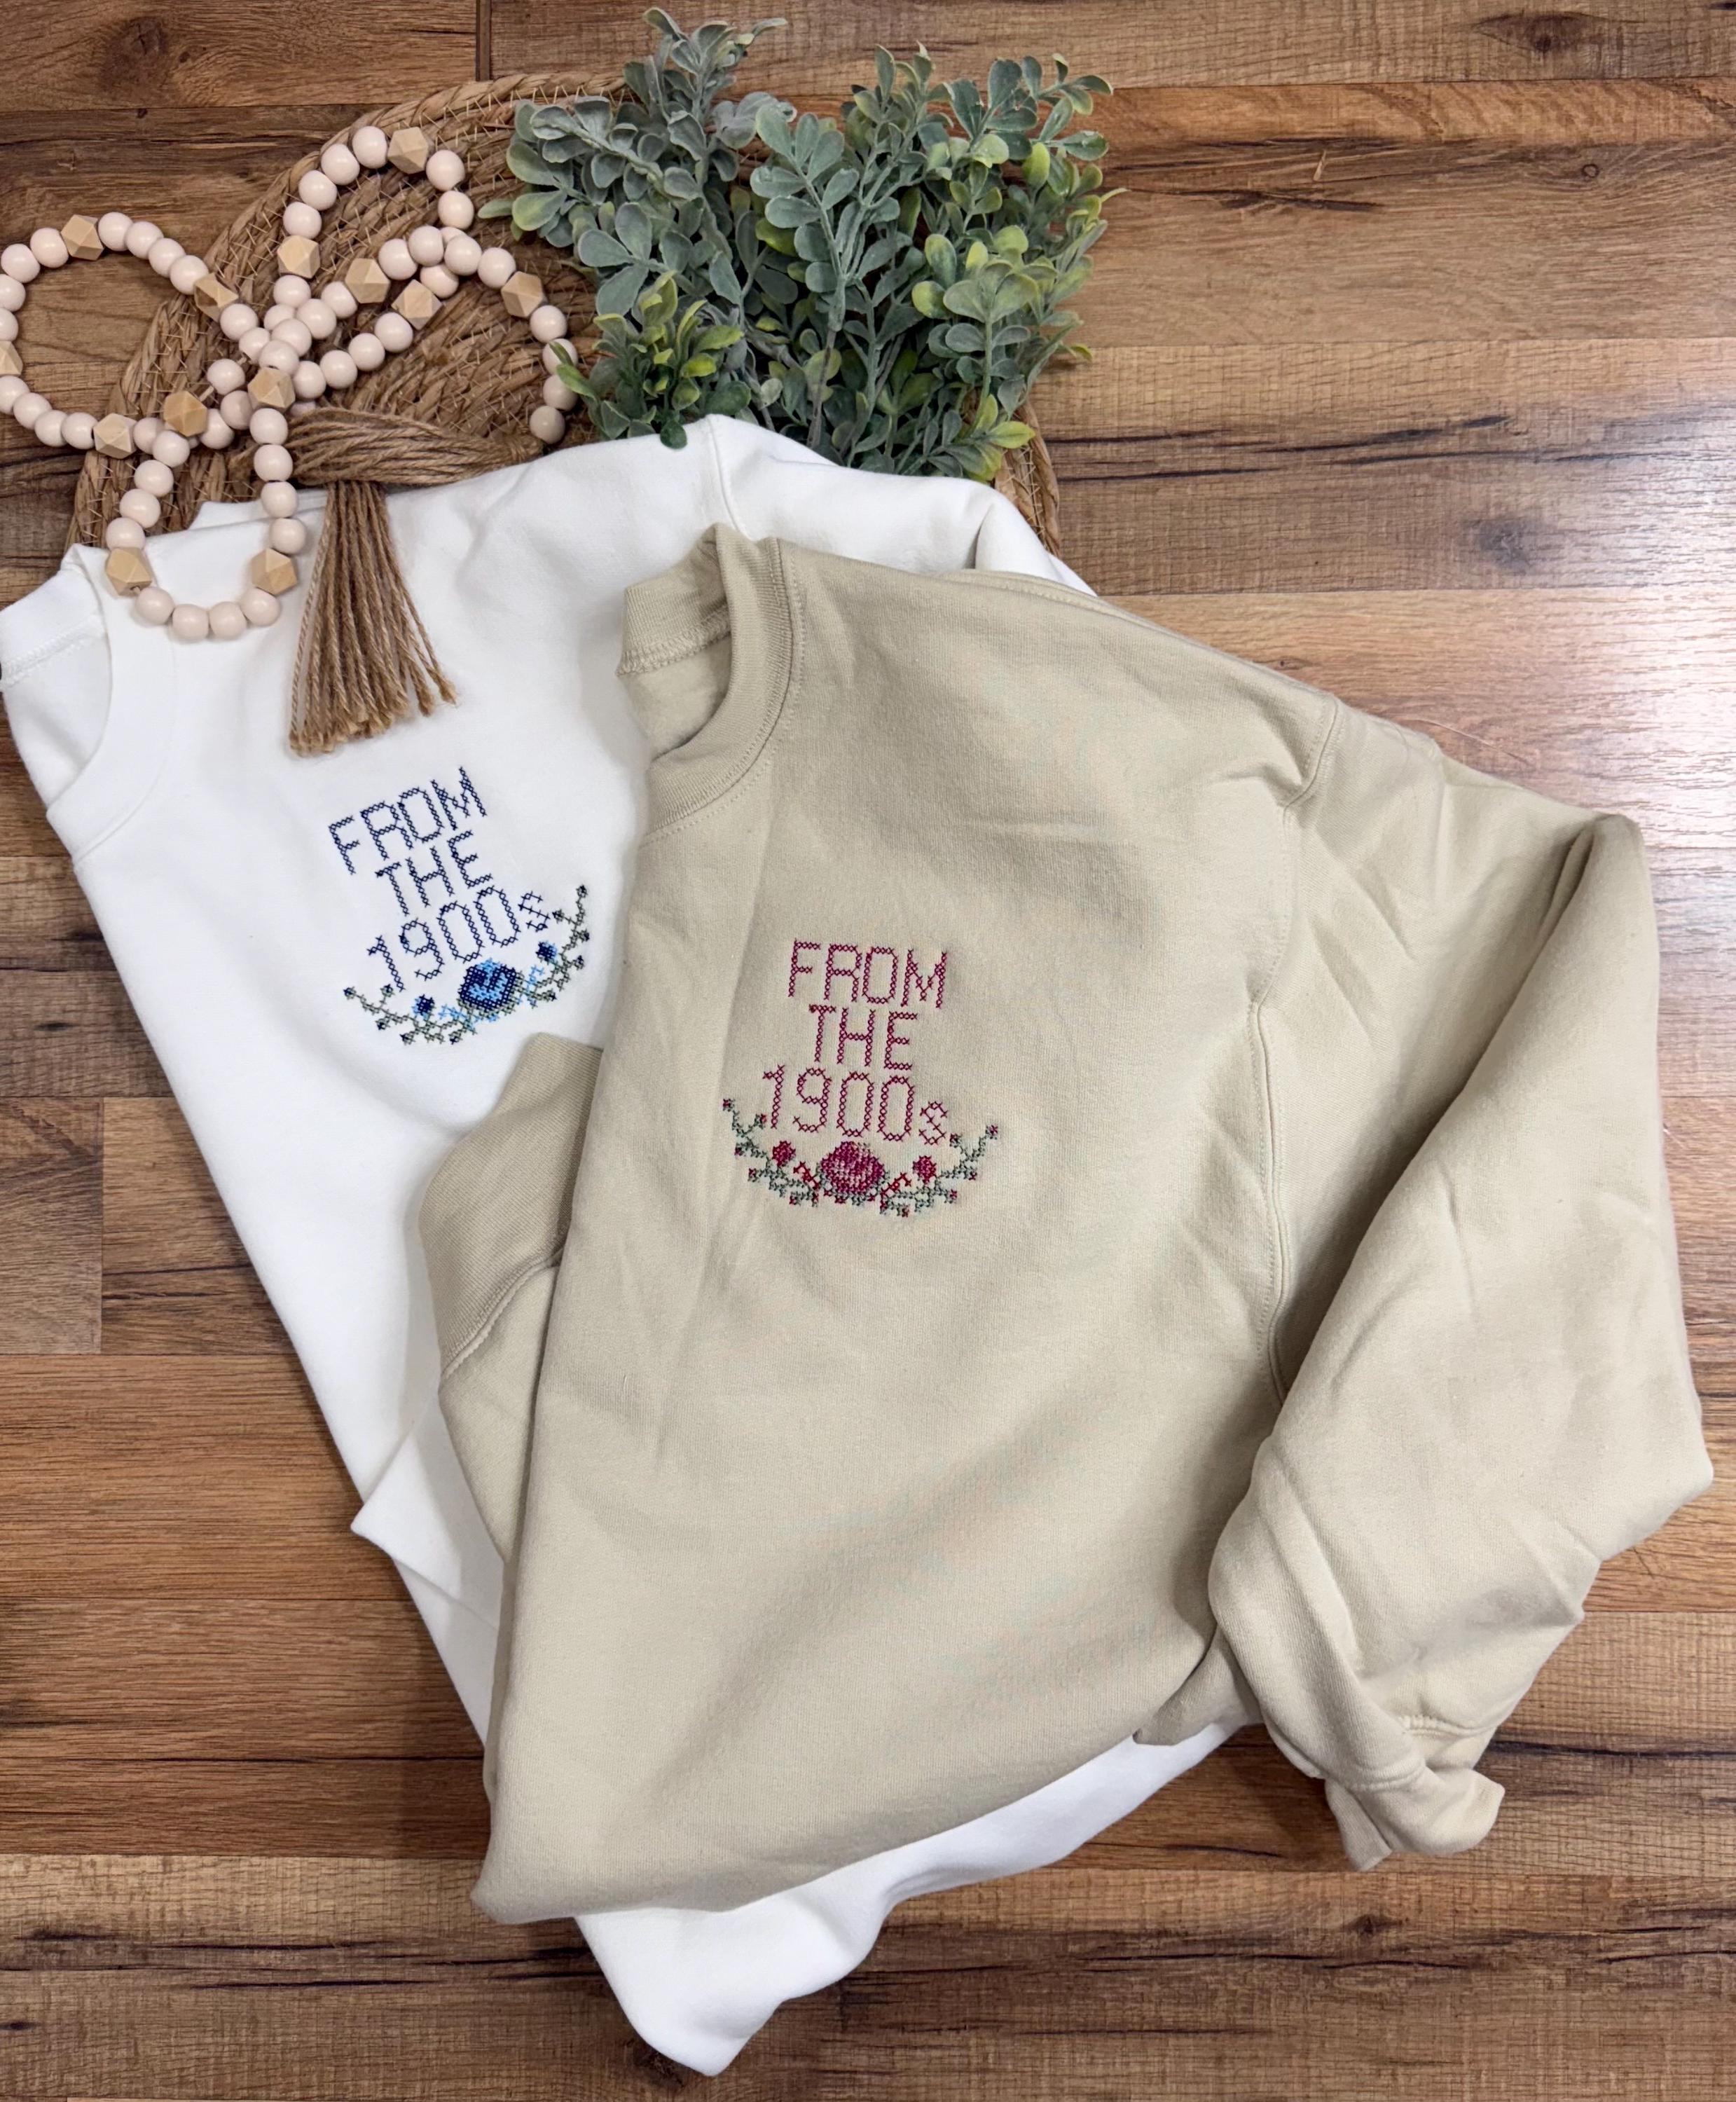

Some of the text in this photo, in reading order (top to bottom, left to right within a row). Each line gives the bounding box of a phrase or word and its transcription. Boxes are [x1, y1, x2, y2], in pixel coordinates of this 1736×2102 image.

[329, 766, 488, 875] FROM
[375, 830, 493, 916] THE
[368, 886, 550, 992] 1900s
[787, 937, 948, 1009] FROM
[808, 1004, 918, 1071] THE
[762, 1064, 949, 1146] 1900s
